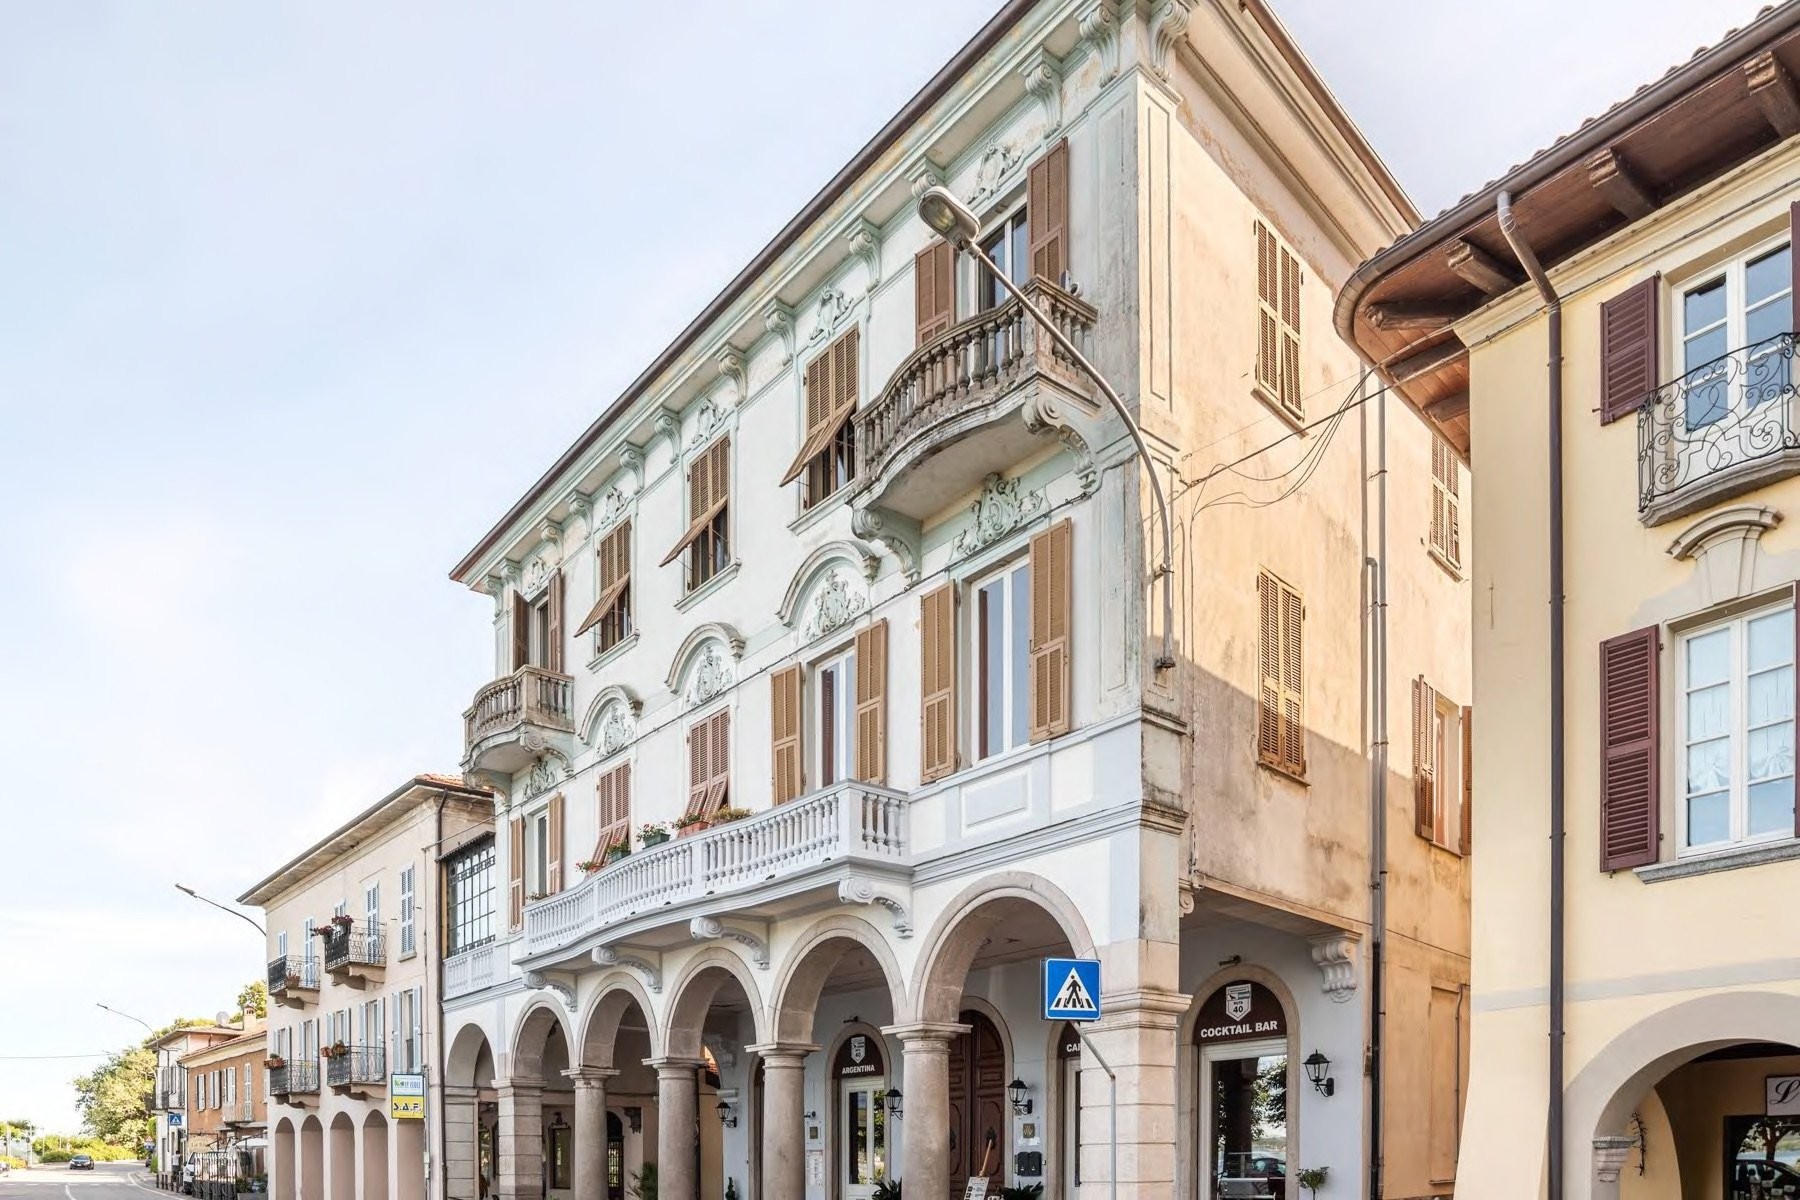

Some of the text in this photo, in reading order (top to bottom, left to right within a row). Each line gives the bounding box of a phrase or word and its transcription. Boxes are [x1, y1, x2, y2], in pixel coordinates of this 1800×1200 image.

[1233, 1005, 1244, 1013] 40
[1201, 1020, 1278, 1038] COCKTAIL BAR
[842, 1064, 875, 1075] ARGENTINA
